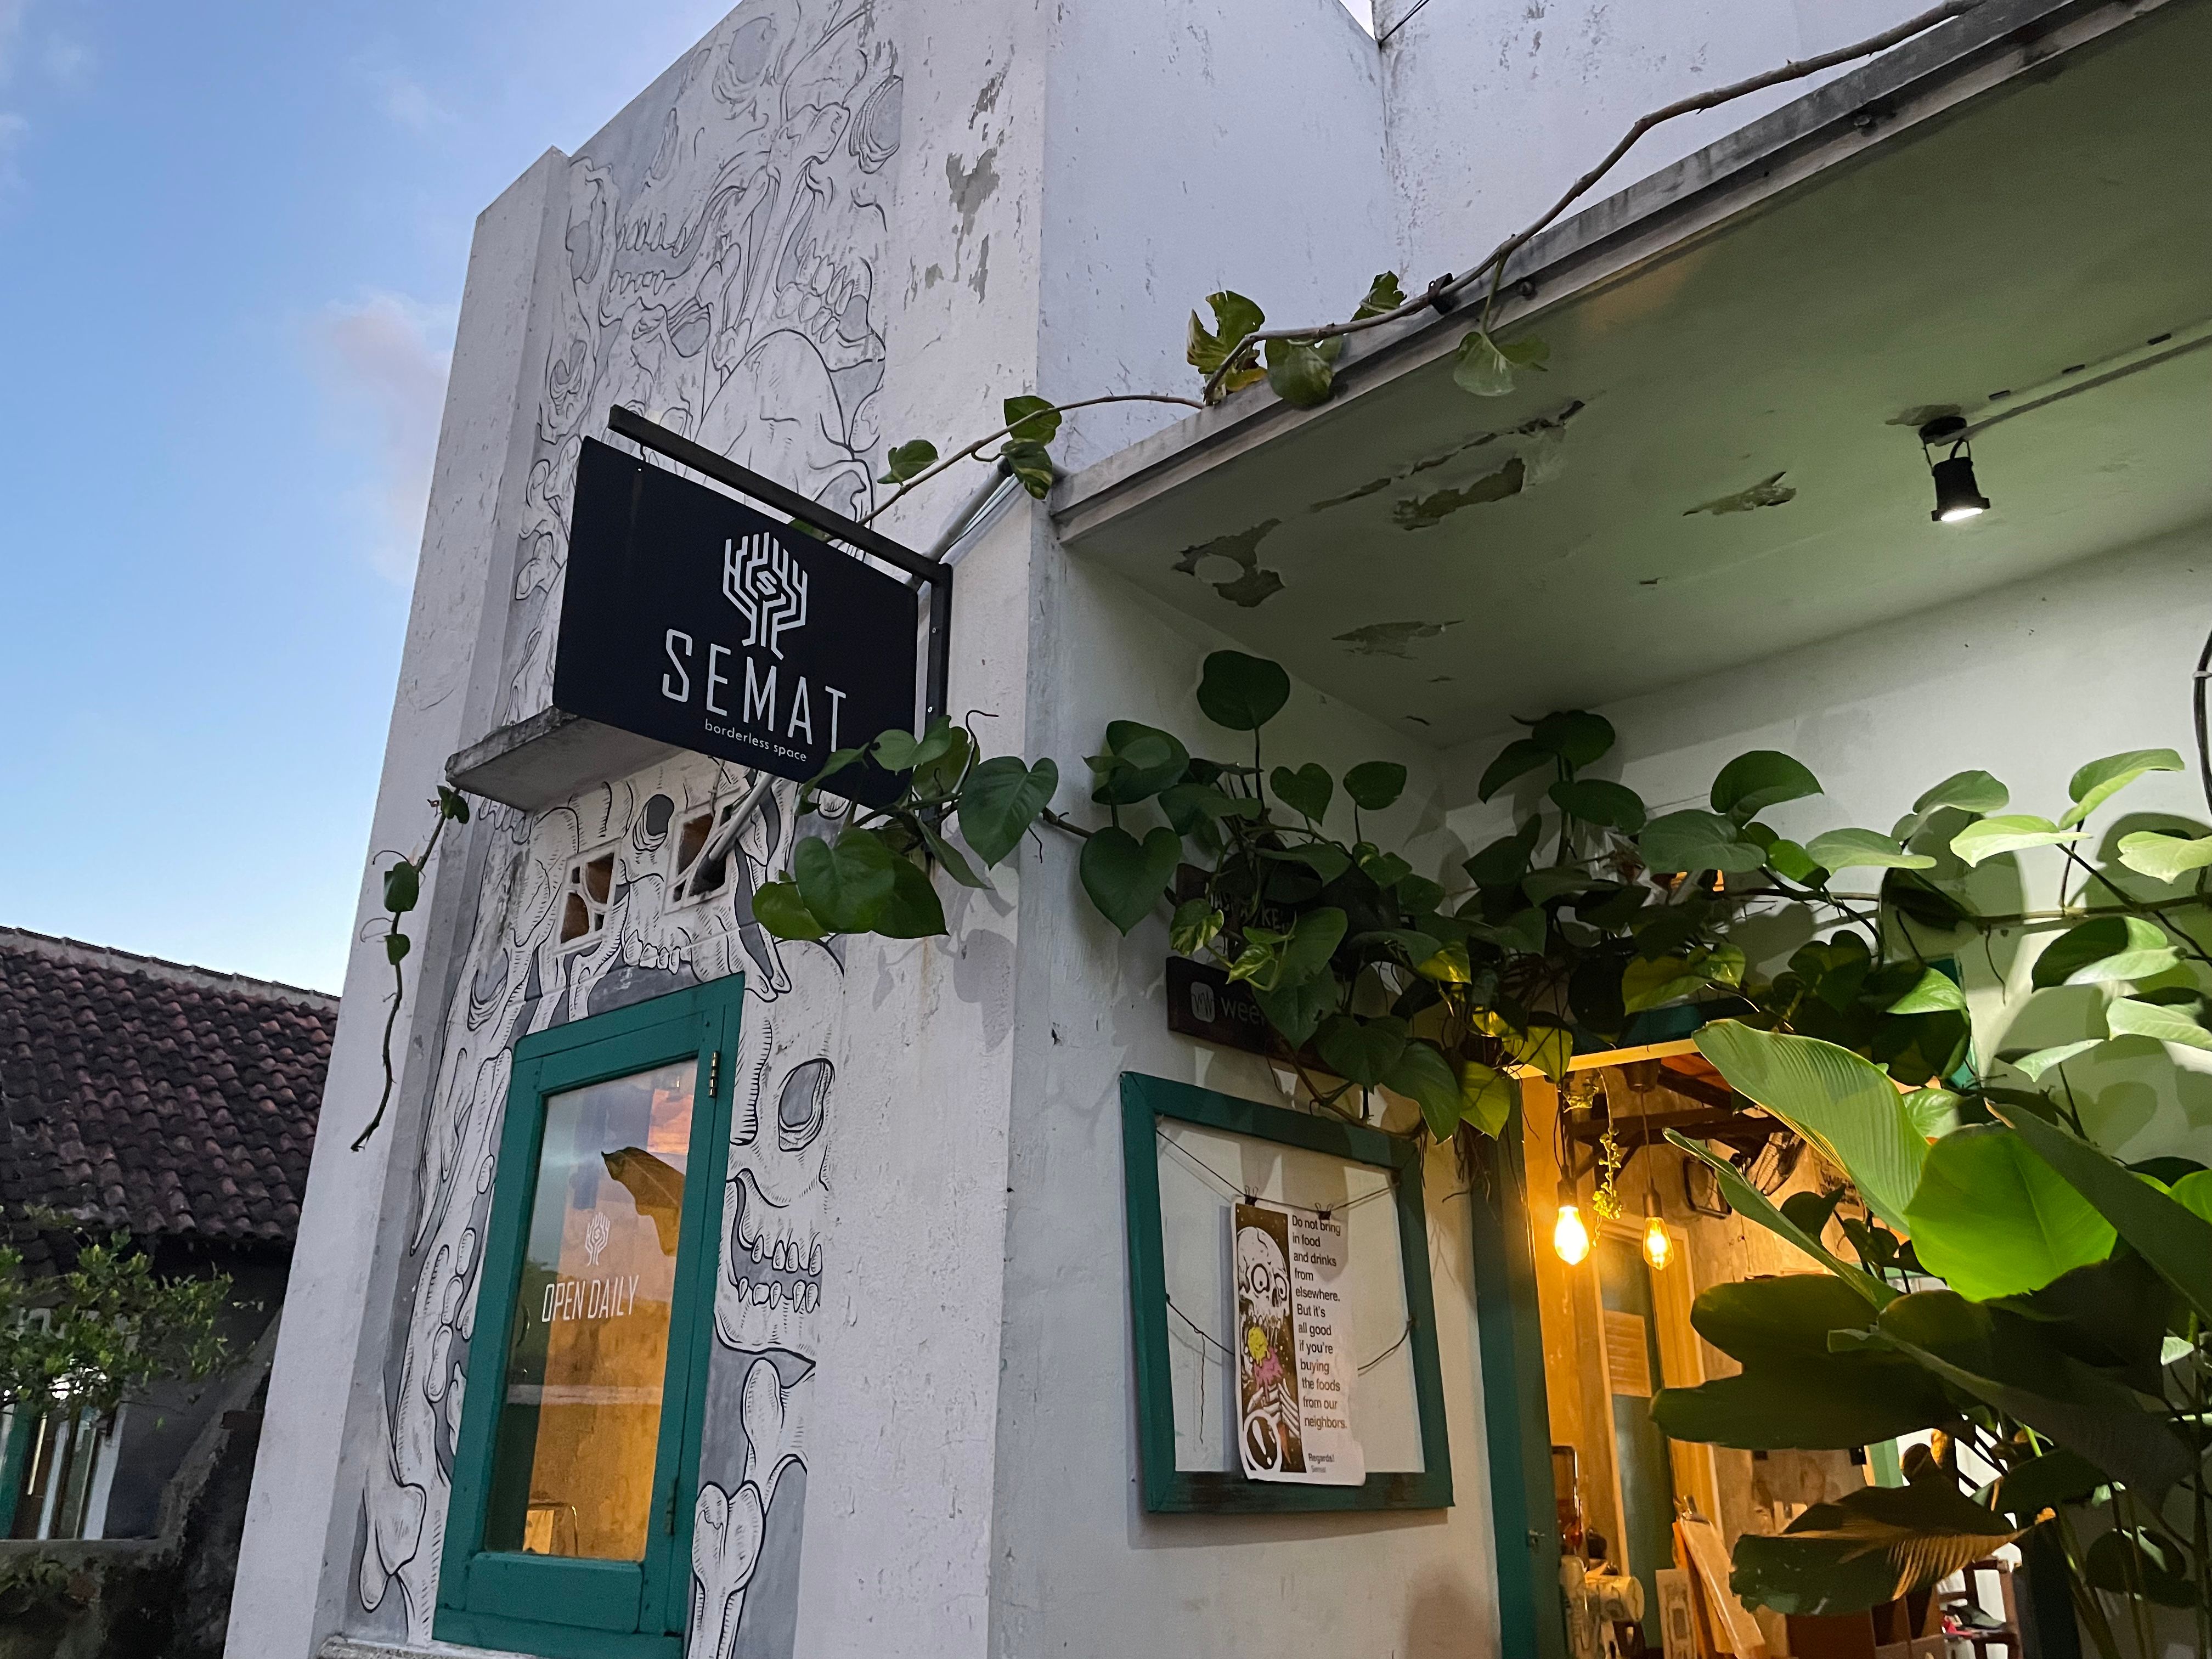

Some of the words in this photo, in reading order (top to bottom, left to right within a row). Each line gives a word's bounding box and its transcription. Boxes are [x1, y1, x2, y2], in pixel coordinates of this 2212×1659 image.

[662, 629, 846, 752] SEMAT
[705, 718, 769, 749] borderless
[773, 744, 806, 761] space
[1292, 1215, 1303, 1227] Do
[1305, 1220, 1318, 1230] not
[1320, 1220, 1341, 1237] bring
[1293, 1232, 1300, 1244] in
[1302, 1234, 1321, 1247] food
[1294, 1252, 1308, 1262] and
[1311, 1252, 1337, 1267] drinks
[1295, 1267, 1313, 1281] from
[541, 1280, 585, 1322] OPEN
[588, 1274, 639, 1319] DAILY
[1295, 1286, 1340, 1302] elsewhere.
[1297, 1303, 1312, 1316] But
[1313, 1305, 1326, 1318] it's
[1298, 1322, 1307, 1333] all
[1310, 1324, 1331, 1337] good
[1299, 1340, 1304, 1351] if
[1306, 1342, 1333, 1355] you're
[1300, 1358, 1329, 1375] buying
[1302, 1377, 1314, 1390] the
[1316, 1378, 1340, 1391] foods
[1303, 1396, 1322, 1408] from
[1324, 1400, 1338, 1409] our
[1304, 1415, 1347, 1430] neighbors.
